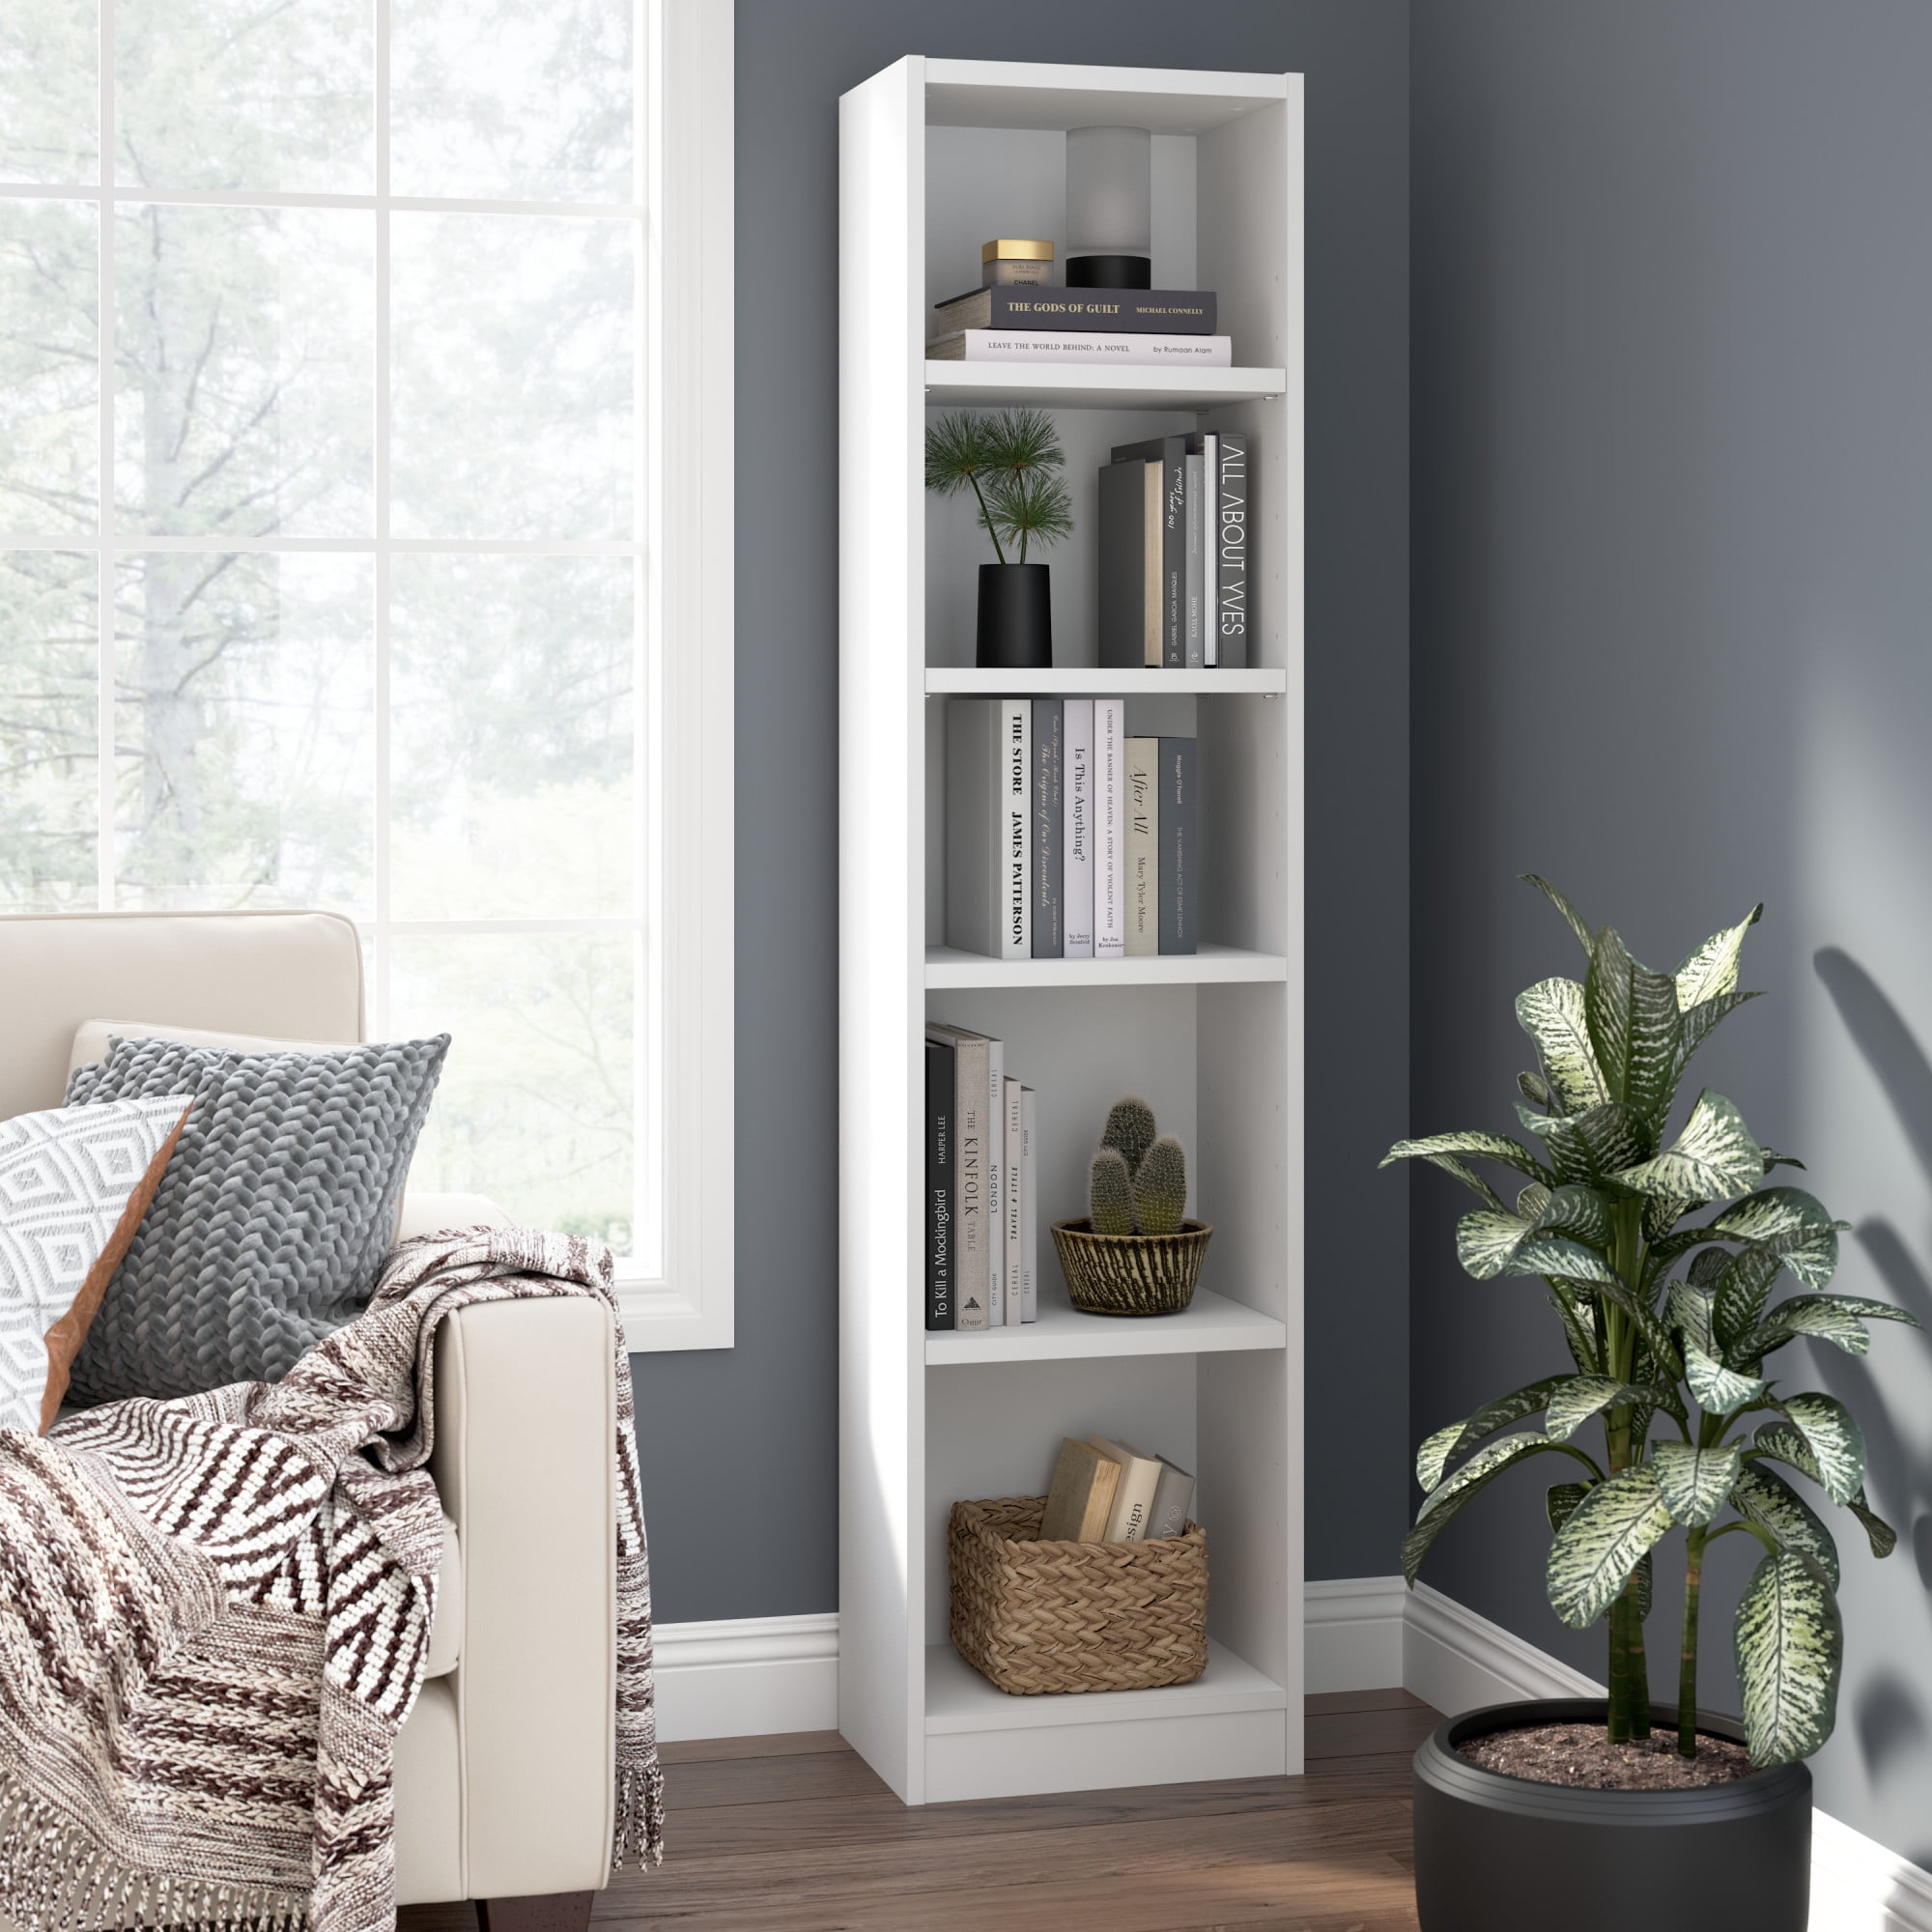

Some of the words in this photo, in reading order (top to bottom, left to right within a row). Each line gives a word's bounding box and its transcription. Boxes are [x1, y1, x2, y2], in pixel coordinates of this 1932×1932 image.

[1008, 301, 1031, 312] THE
[1034, 302, 1065, 313] GODS
[1068, 302, 1084, 313] OF
[1086, 303, 1120, 314] GUILT
[1222, 443, 1244, 485] ALL
[1175, 496, 1184, 505] of
[1222, 493, 1244, 571] ABOUT
[1222, 581, 1244, 636] YVES
[1012, 714, 1022, 743] THE
[1041, 744, 1051, 764] The
[1074, 749, 1085, 760] Is
[1012, 749, 1022, 796] STORE
[1074, 764, 1085, 792] This
[1129, 765, 1148, 807] After
[1038, 768, 1050, 806] Origins
[1107, 784, 1113, 793] OF
[1037, 810, 1050, 822] of
[1073, 796, 1085, 862] Anything?
[1134, 810, 1148, 835] All
[1011, 812, 1022, 859] JAMES
[1041, 823, 1050, 843] Our
[1041, 846, 1051, 907] Discontents
[1107, 862, 1113, 870] OF
[1136, 857, 1147, 879] Mary
[1012, 864, 1023, 946] PATTERSON
[1136, 881, 1147, 905] Tyler
[967, 1111, 976, 1129] THE
[964, 1137, 979, 1216] KINFOLK
[935, 1189, 950, 1264] Mockingbird
[967, 1222, 976, 1252] TABLE
[935, 1278, 947, 1298] Kill
[935, 1301, 947, 1318] To
